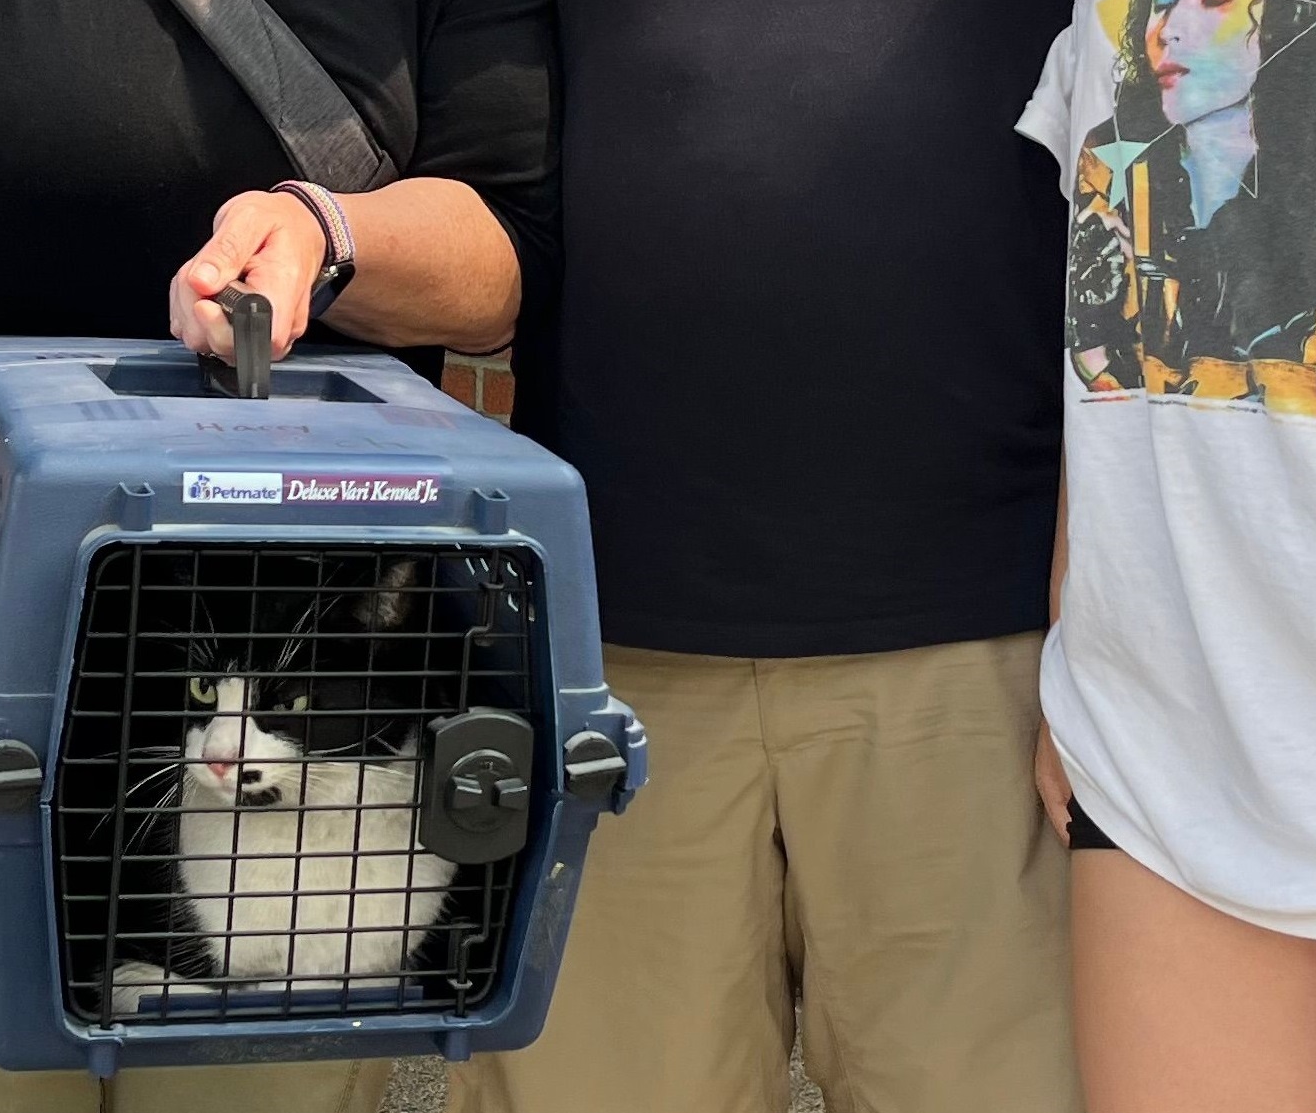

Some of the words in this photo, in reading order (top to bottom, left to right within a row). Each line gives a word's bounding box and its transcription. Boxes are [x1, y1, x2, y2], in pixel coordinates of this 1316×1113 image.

[287, 480, 339, 502] Deluxe
[340, 480, 369, 501] Vari
[370, 480, 421, 501] Kennel
[420, 478, 438, 503] Jr.
